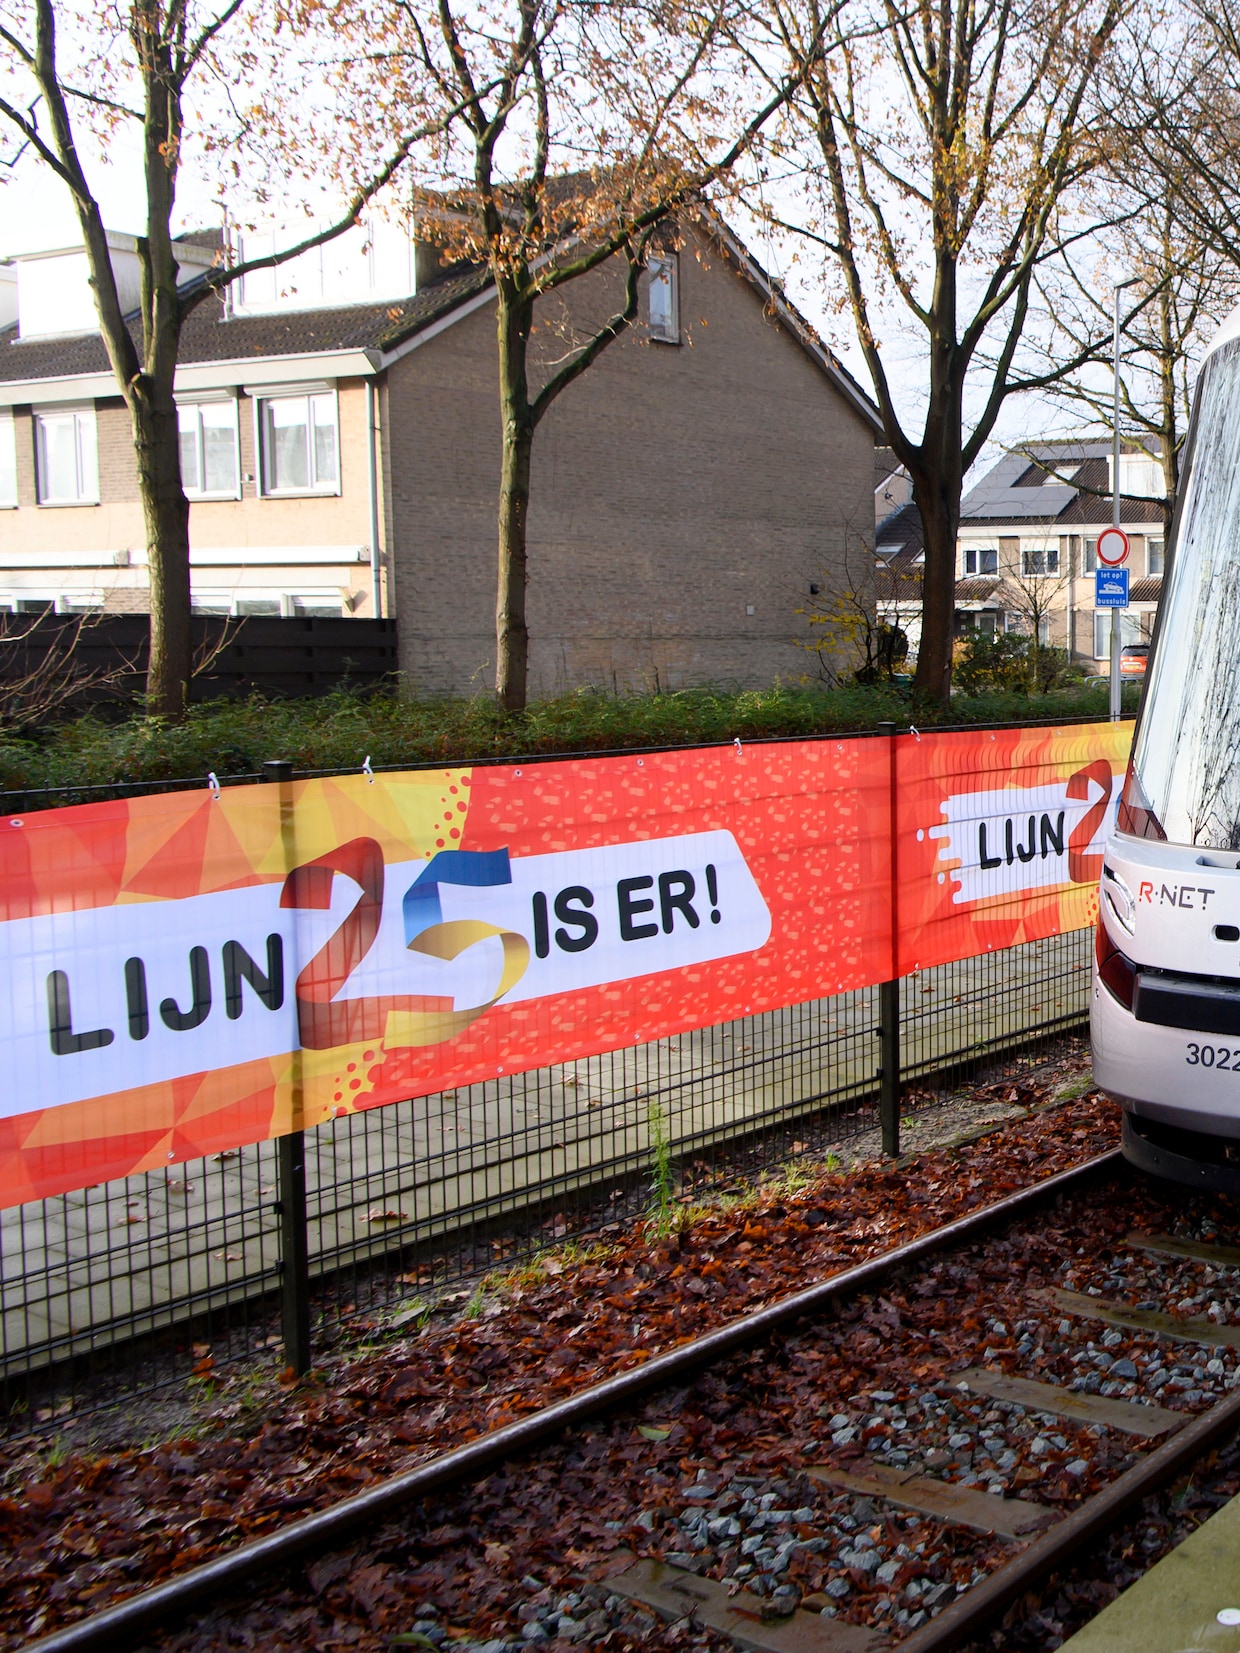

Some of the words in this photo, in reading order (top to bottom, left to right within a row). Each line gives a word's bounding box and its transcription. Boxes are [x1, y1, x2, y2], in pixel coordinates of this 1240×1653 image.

[1100, 571, 1110, 579] let
[1111, 571, 1123, 580] op!
[1097, 597, 1126, 605] bussluis
[979, 811, 1065, 870] LIJN
[46, 932, 285, 1056] LIJN
[279, 836, 531, 1051] 25
[532, 885, 599, 959] IS
[617, 863, 722, 942] ER!
